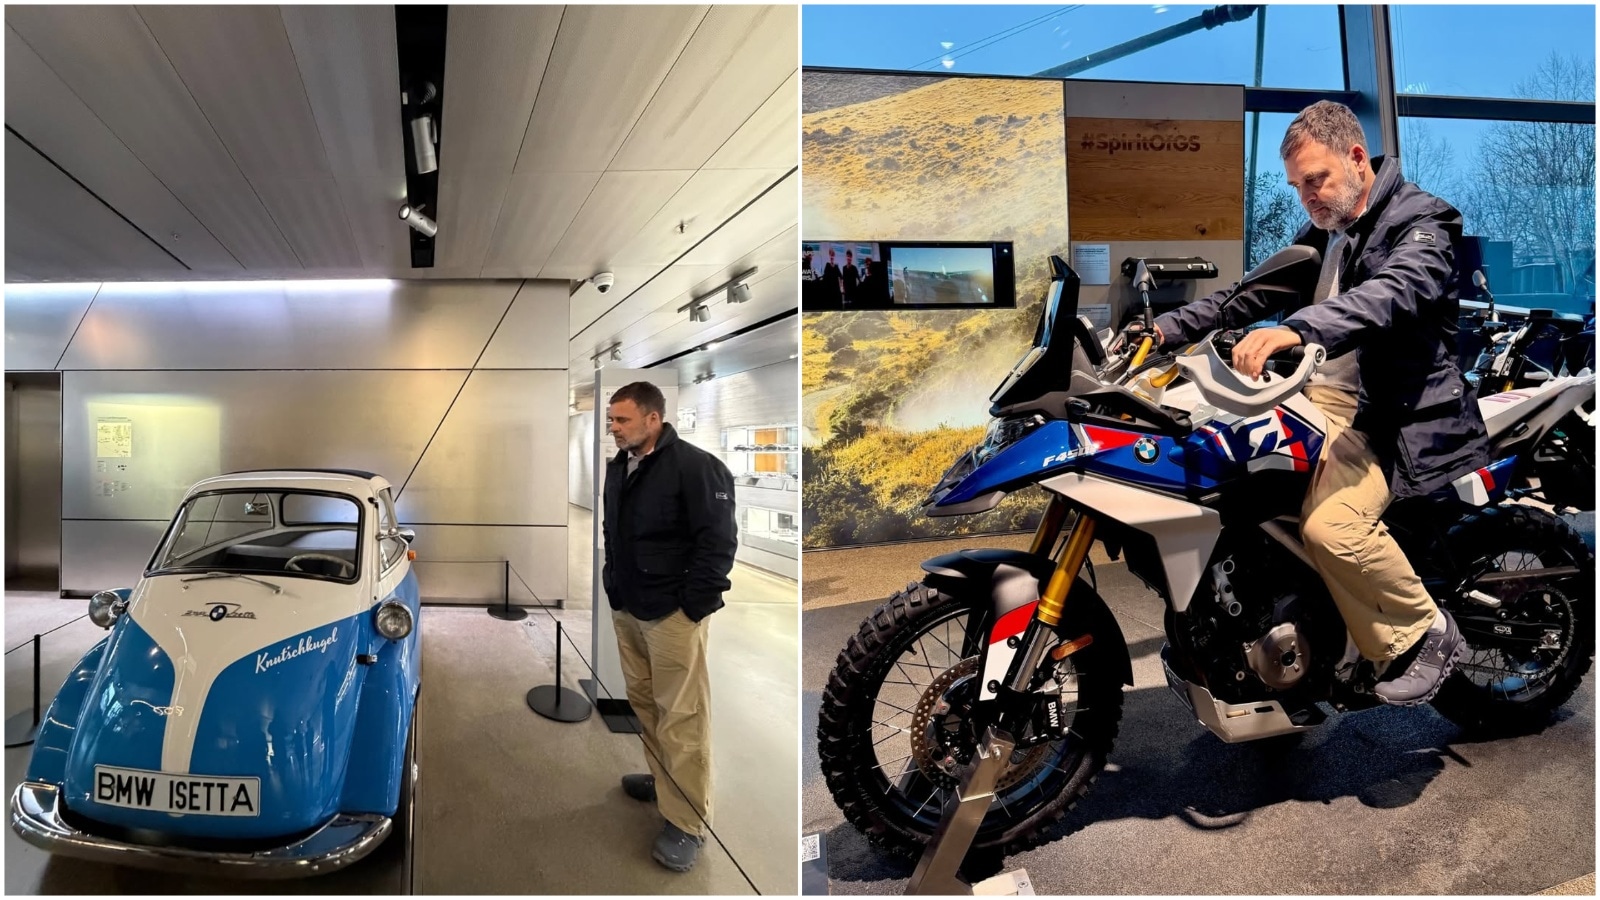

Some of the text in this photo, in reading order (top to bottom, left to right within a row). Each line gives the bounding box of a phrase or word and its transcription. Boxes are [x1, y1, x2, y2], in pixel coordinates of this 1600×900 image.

[1081, 133, 1200, 155] #SpiritOfGS
[255, 626, 338, 674] Knutschkugel
[1047, 701, 1060, 728] BMW
[98, 772, 254, 813] BMW ISETTA
